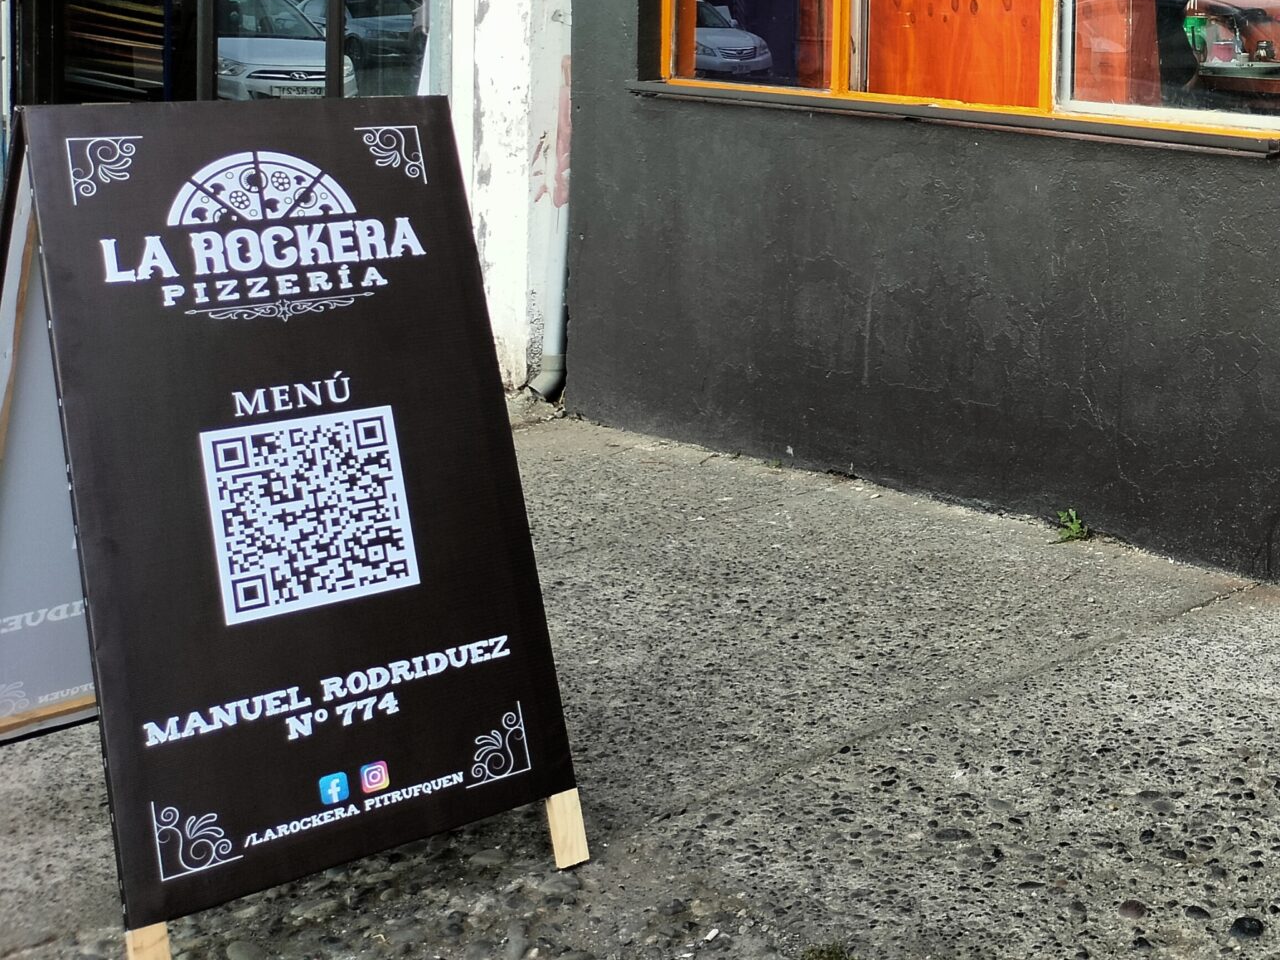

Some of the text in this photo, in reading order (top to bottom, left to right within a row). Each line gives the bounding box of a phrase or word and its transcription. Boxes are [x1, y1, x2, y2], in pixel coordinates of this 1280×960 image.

[100, 217, 426, 283] LA ROCKERA
[161, 264, 388, 306] PIZZERÍA
[231, 370, 351, 417] MENÚ
[143, 635, 510, 746] MANUEL RODRIDUEZ
[336, 691, 399, 726] 774
[244, 772, 464, 848] /LAROCKERA PITRUFQUEN
